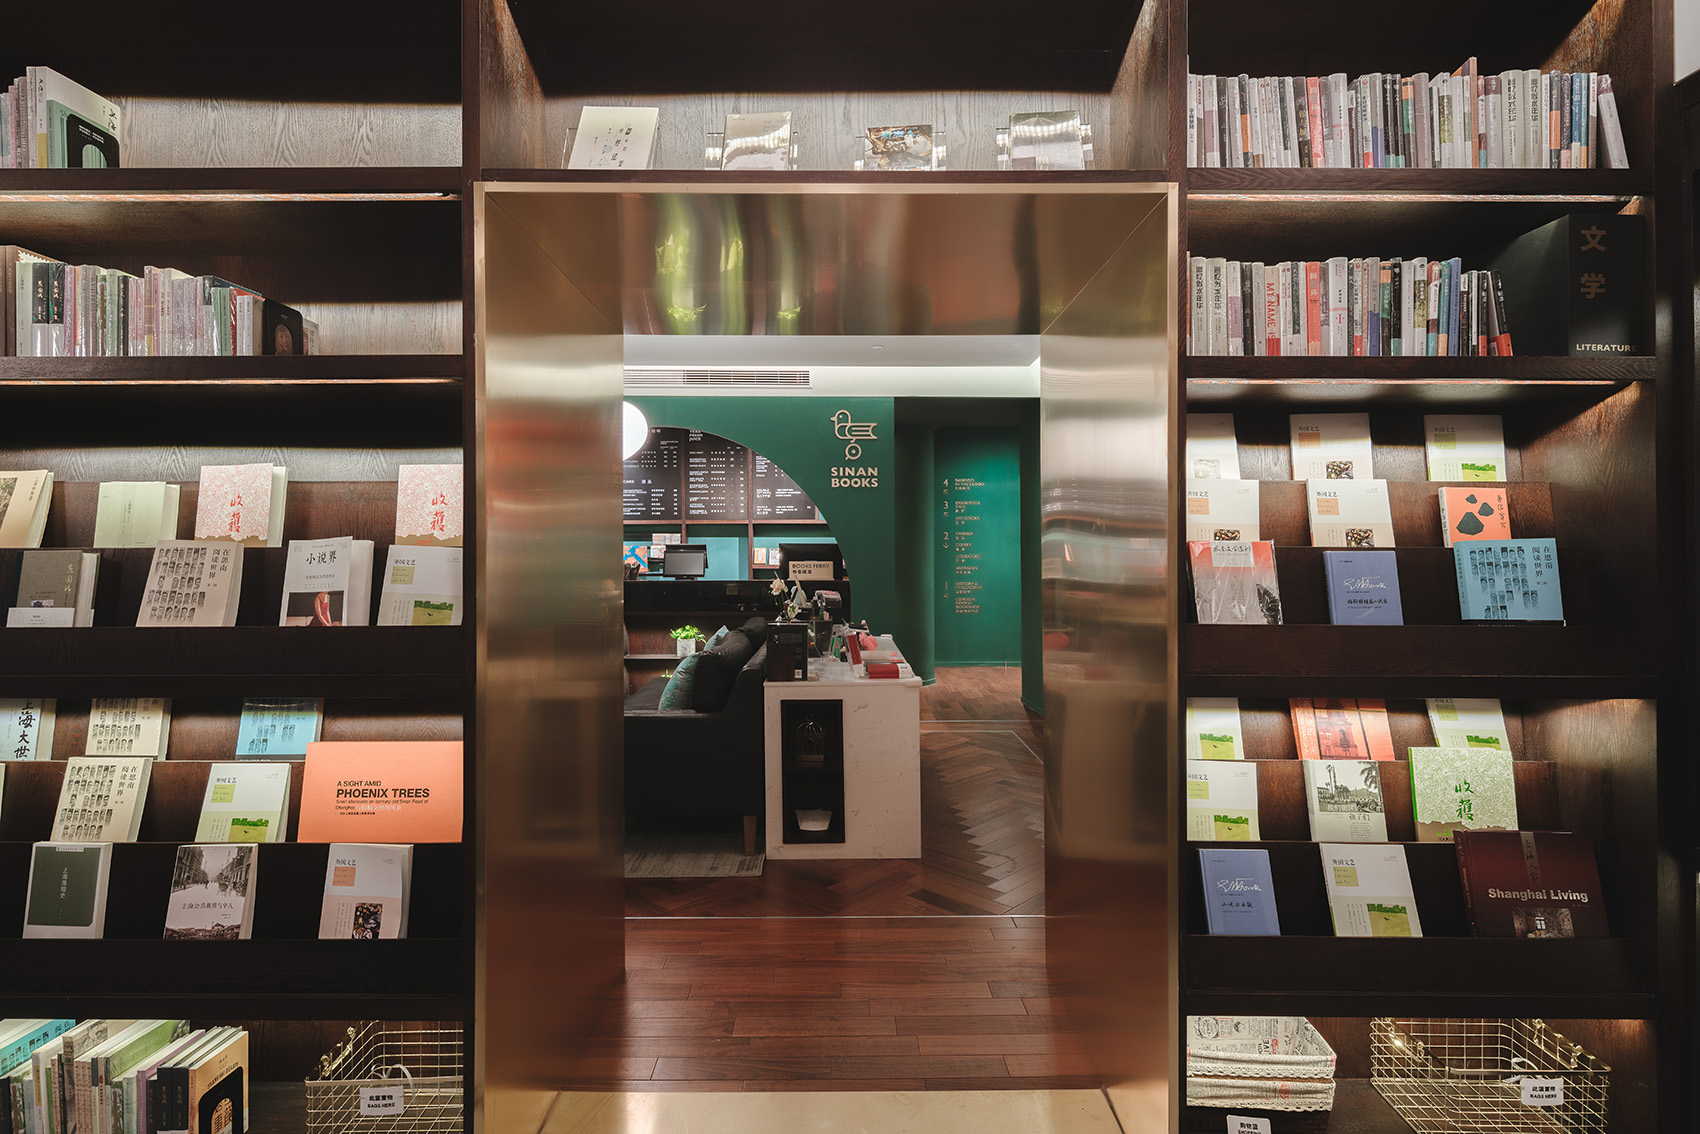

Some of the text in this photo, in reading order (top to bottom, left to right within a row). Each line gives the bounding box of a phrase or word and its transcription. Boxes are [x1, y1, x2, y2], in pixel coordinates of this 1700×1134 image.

[1580, 225, 1606, 299] 文学
[1266, 283, 1275, 296] MY
[1267, 301, 1276, 328] NAME
[1576, 344, 1637, 352] LITERATURE
[831, 467, 878, 476] SINAN
[831, 478, 879, 488] BOOKS
[943, 501, 949, 509] 3
[943, 531, 949, 540] 2
[208, 548, 220, 579] 阅读世界
[219, 549, 230, 572] 在思南
[306, 549, 337, 565] 小说界
[1532, 546, 1543, 577] 阅读世界
[1543, 546, 1553, 569] 在思南
[13, 700, 36, 761] 上海大世
[336, 788, 430, 798] PHOENIX TREES
[1349, 813, 1371, 821] 孩子们
[1525, 839, 1539, 881] 上海人家
[1487, 888, 1588, 903] Shanghai Living
